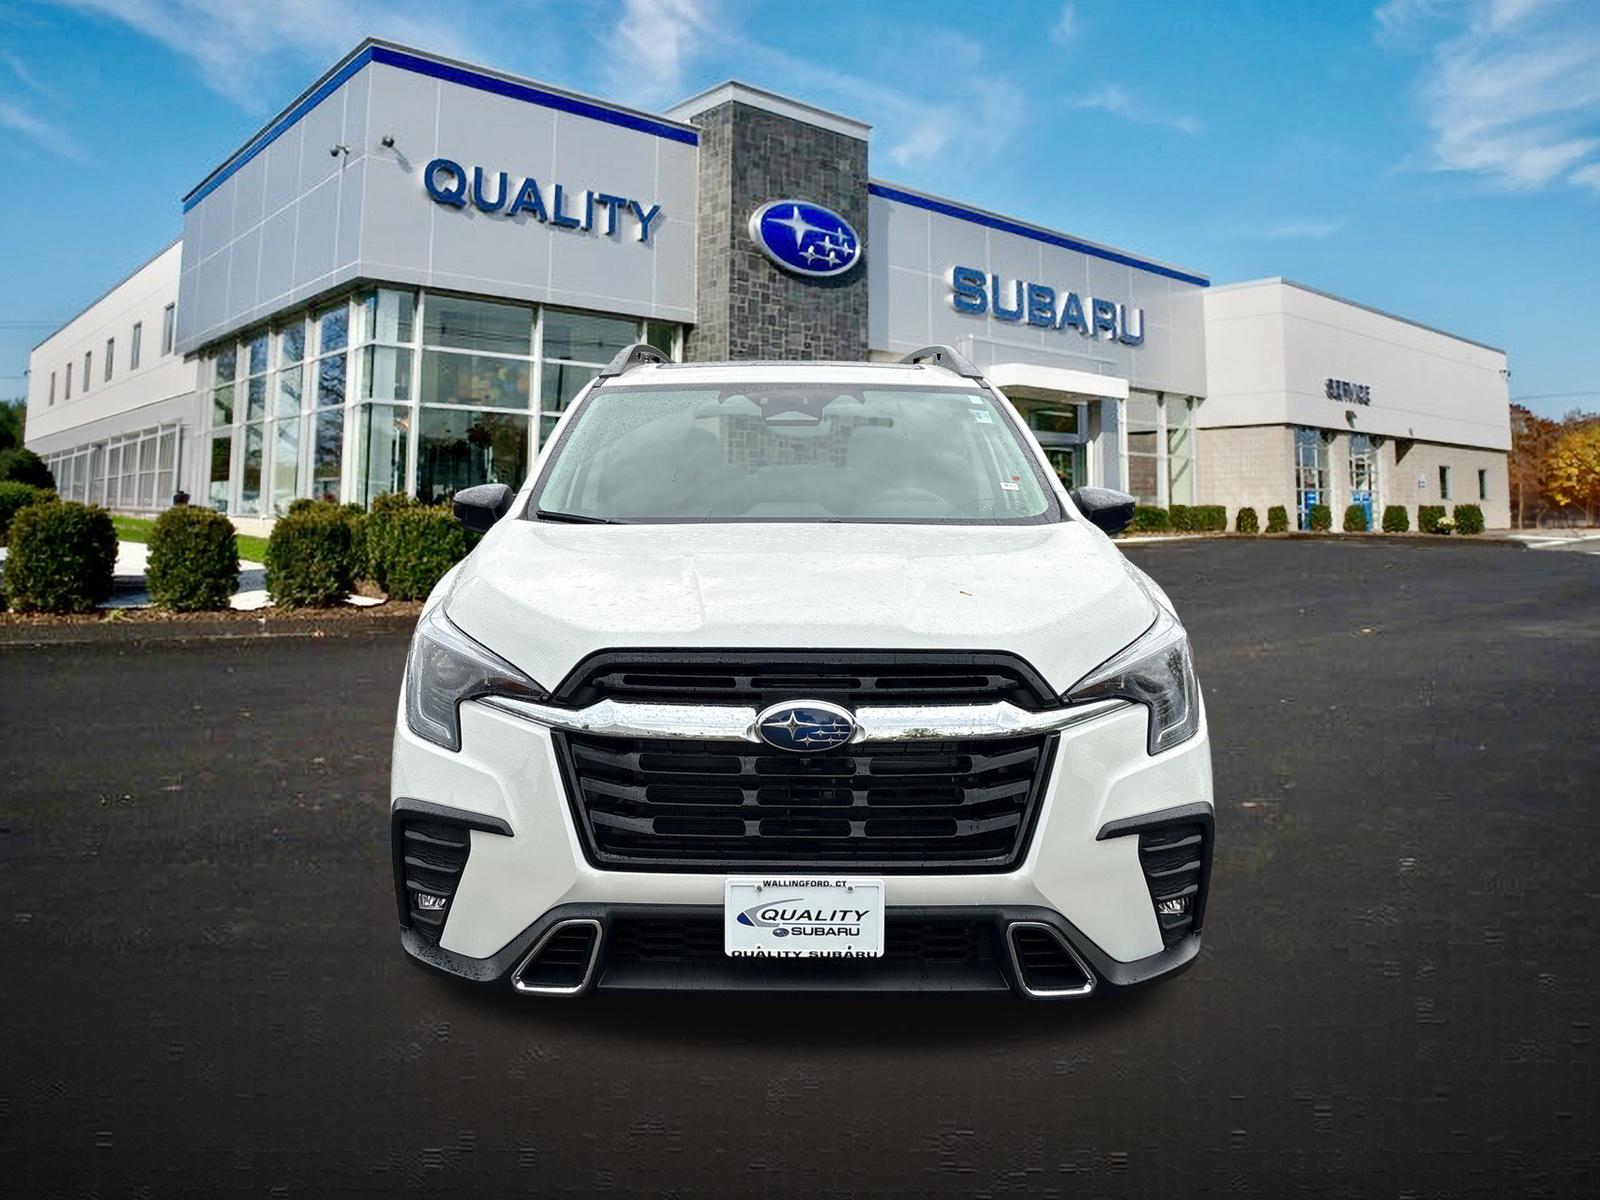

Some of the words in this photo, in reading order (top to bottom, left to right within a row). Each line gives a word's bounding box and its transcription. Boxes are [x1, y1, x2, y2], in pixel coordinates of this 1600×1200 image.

[423, 158, 662, 243] QUALITY
[949, 265, 1145, 346] SUBARU
[1325, 377, 1371, 407] SERVICE
[835, 880, 847, 888] CT
[760, 908, 869, 922] QUALITY
[790, 927, 860, 937] SUBARU
[731, 950, 802, 958] QUALITY
[808, 950, 878, 958] SUBARU
